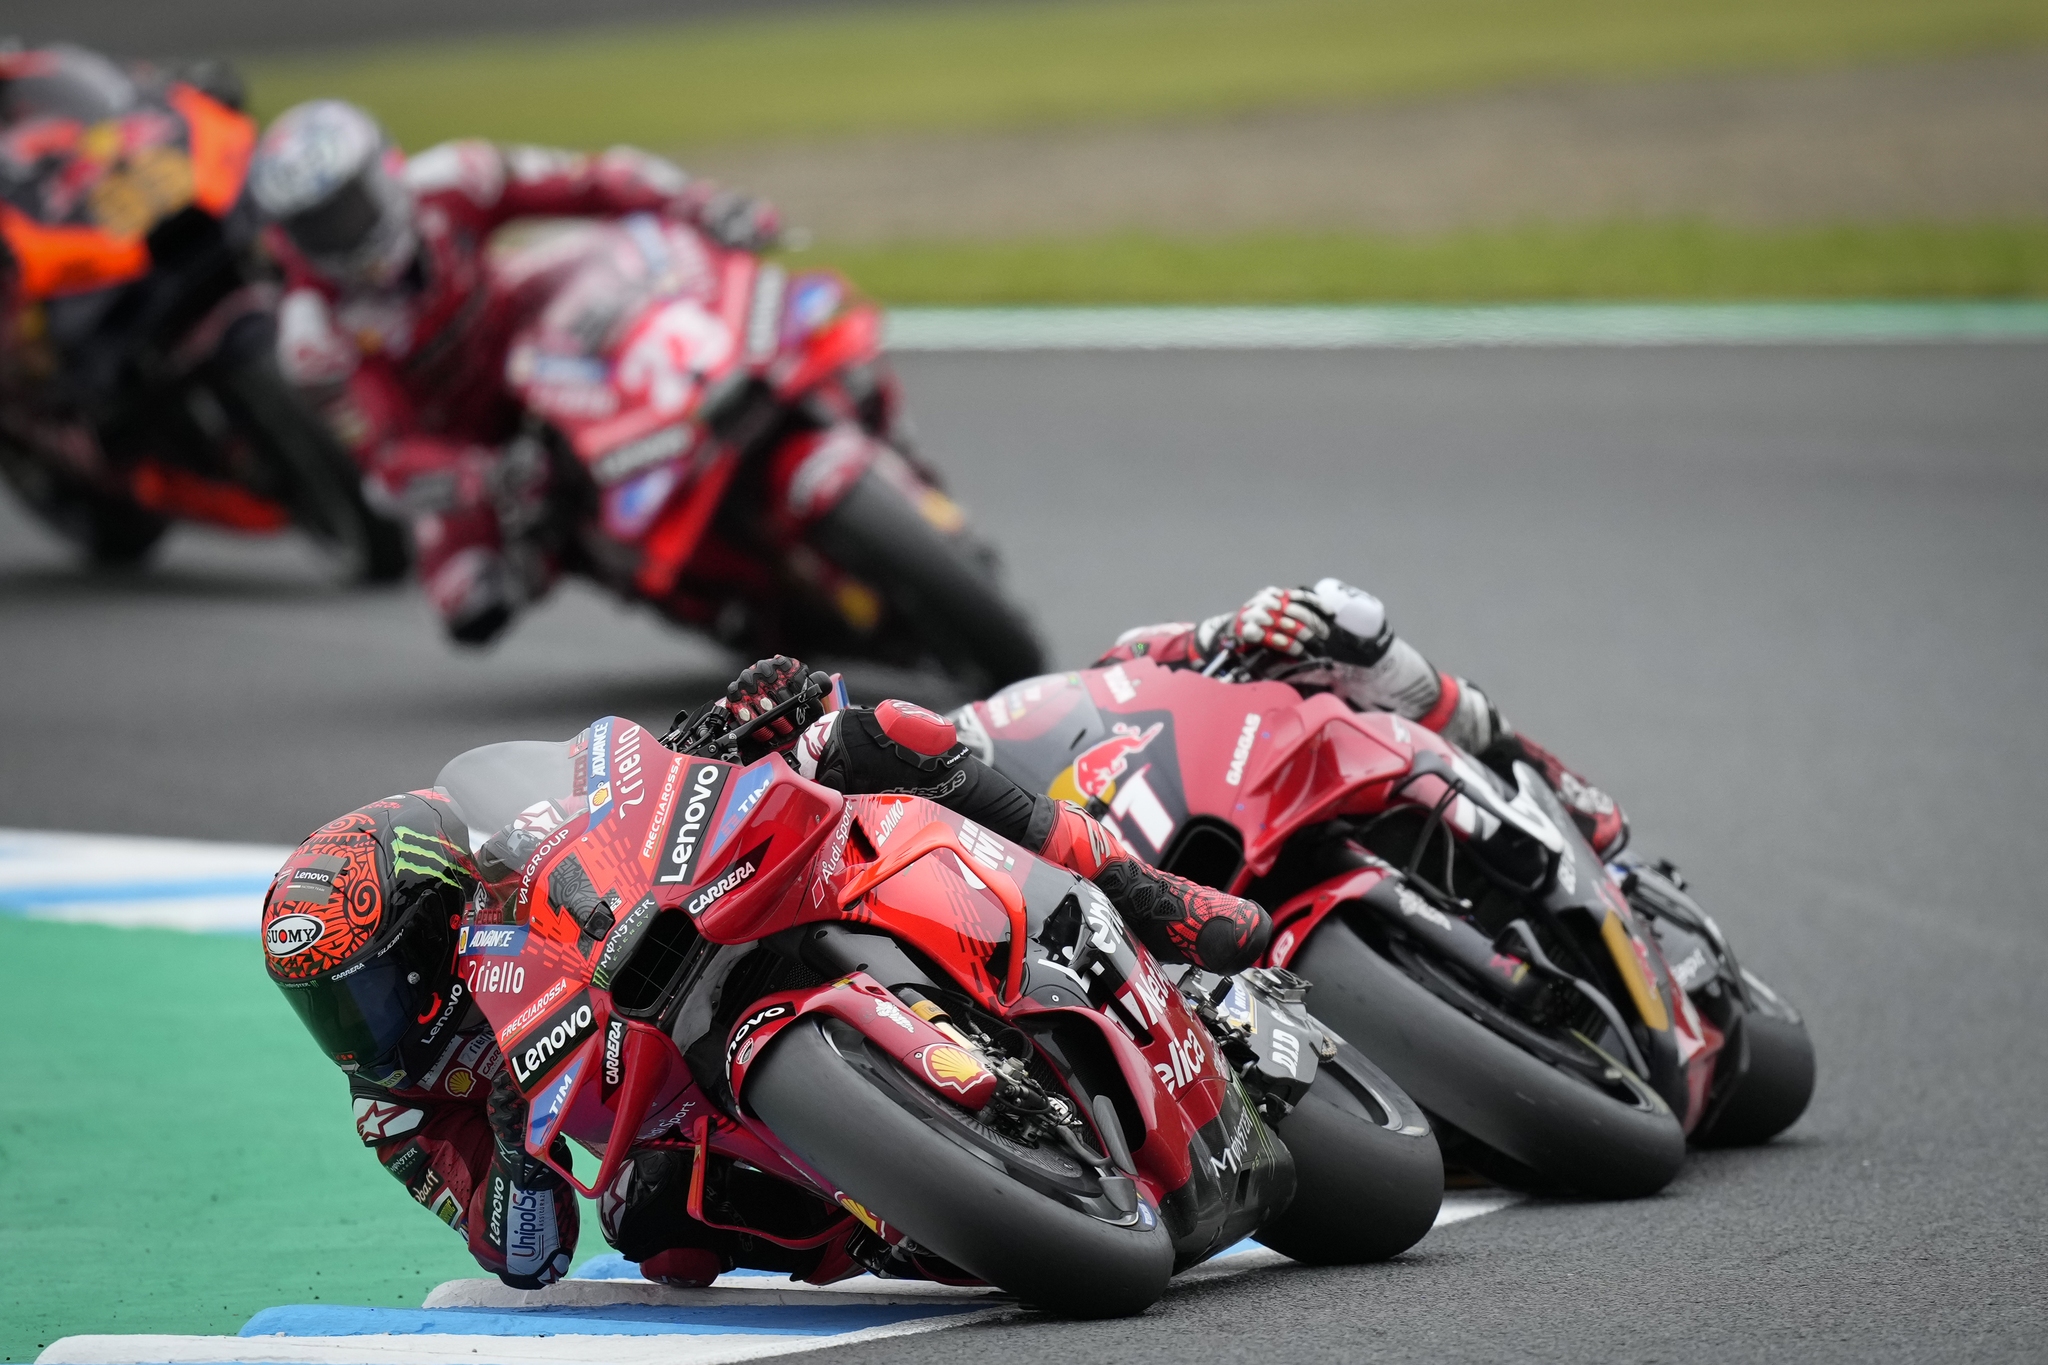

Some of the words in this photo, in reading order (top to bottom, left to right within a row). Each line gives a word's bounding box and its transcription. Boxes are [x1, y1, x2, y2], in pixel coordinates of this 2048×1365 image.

[591, 722, 609, 777] ADVANCE
[643, 756, 682, 858] FRECCIAROSSA
[660, 765, 719, 882] Lenovo
[738, 779, 770, 813] TIM
[880, 799, 904, 839] DAIKO
[1102, 763, 1175, 863] 1
[518, 829, 569, 905] VARGROUP
[822, 839, 842, 885] Audi
[836, 801, 853, 841] Sport
[295, 870, 329, 882] Lenovo
[688, 861, 756, 915] CARRERA
[267, 928, 315, 944] SUOMY
[377, 928, 405, 958] SUOMY
[469, 930, 515, 947] ADVANCE
[476, 909, 503, 925] PECCO
[601, 899, 655, 969] MONSTER
[613, 914, 649, 961] ENERGY
[331, 962, 365, 981] CARRERA
[421, 984, 462, 1044] Lenovo
[501, 978, 567, 1041] FRECCIAROSSA
[482, 1047, 502, 1076] CARR
[511, 1005, 592, 1083] Lenovo
[606, 1020, 623, 1085] CARRERA
[1153, 1028, 1204, 1095] elica
[549, 1073, 573, 1115] TIM
[659, 1101, 696, 1128] Sport
[489, 1177, 504, 1246] Lenovo
[511, 1189, 544, 1257] UnipolSa
